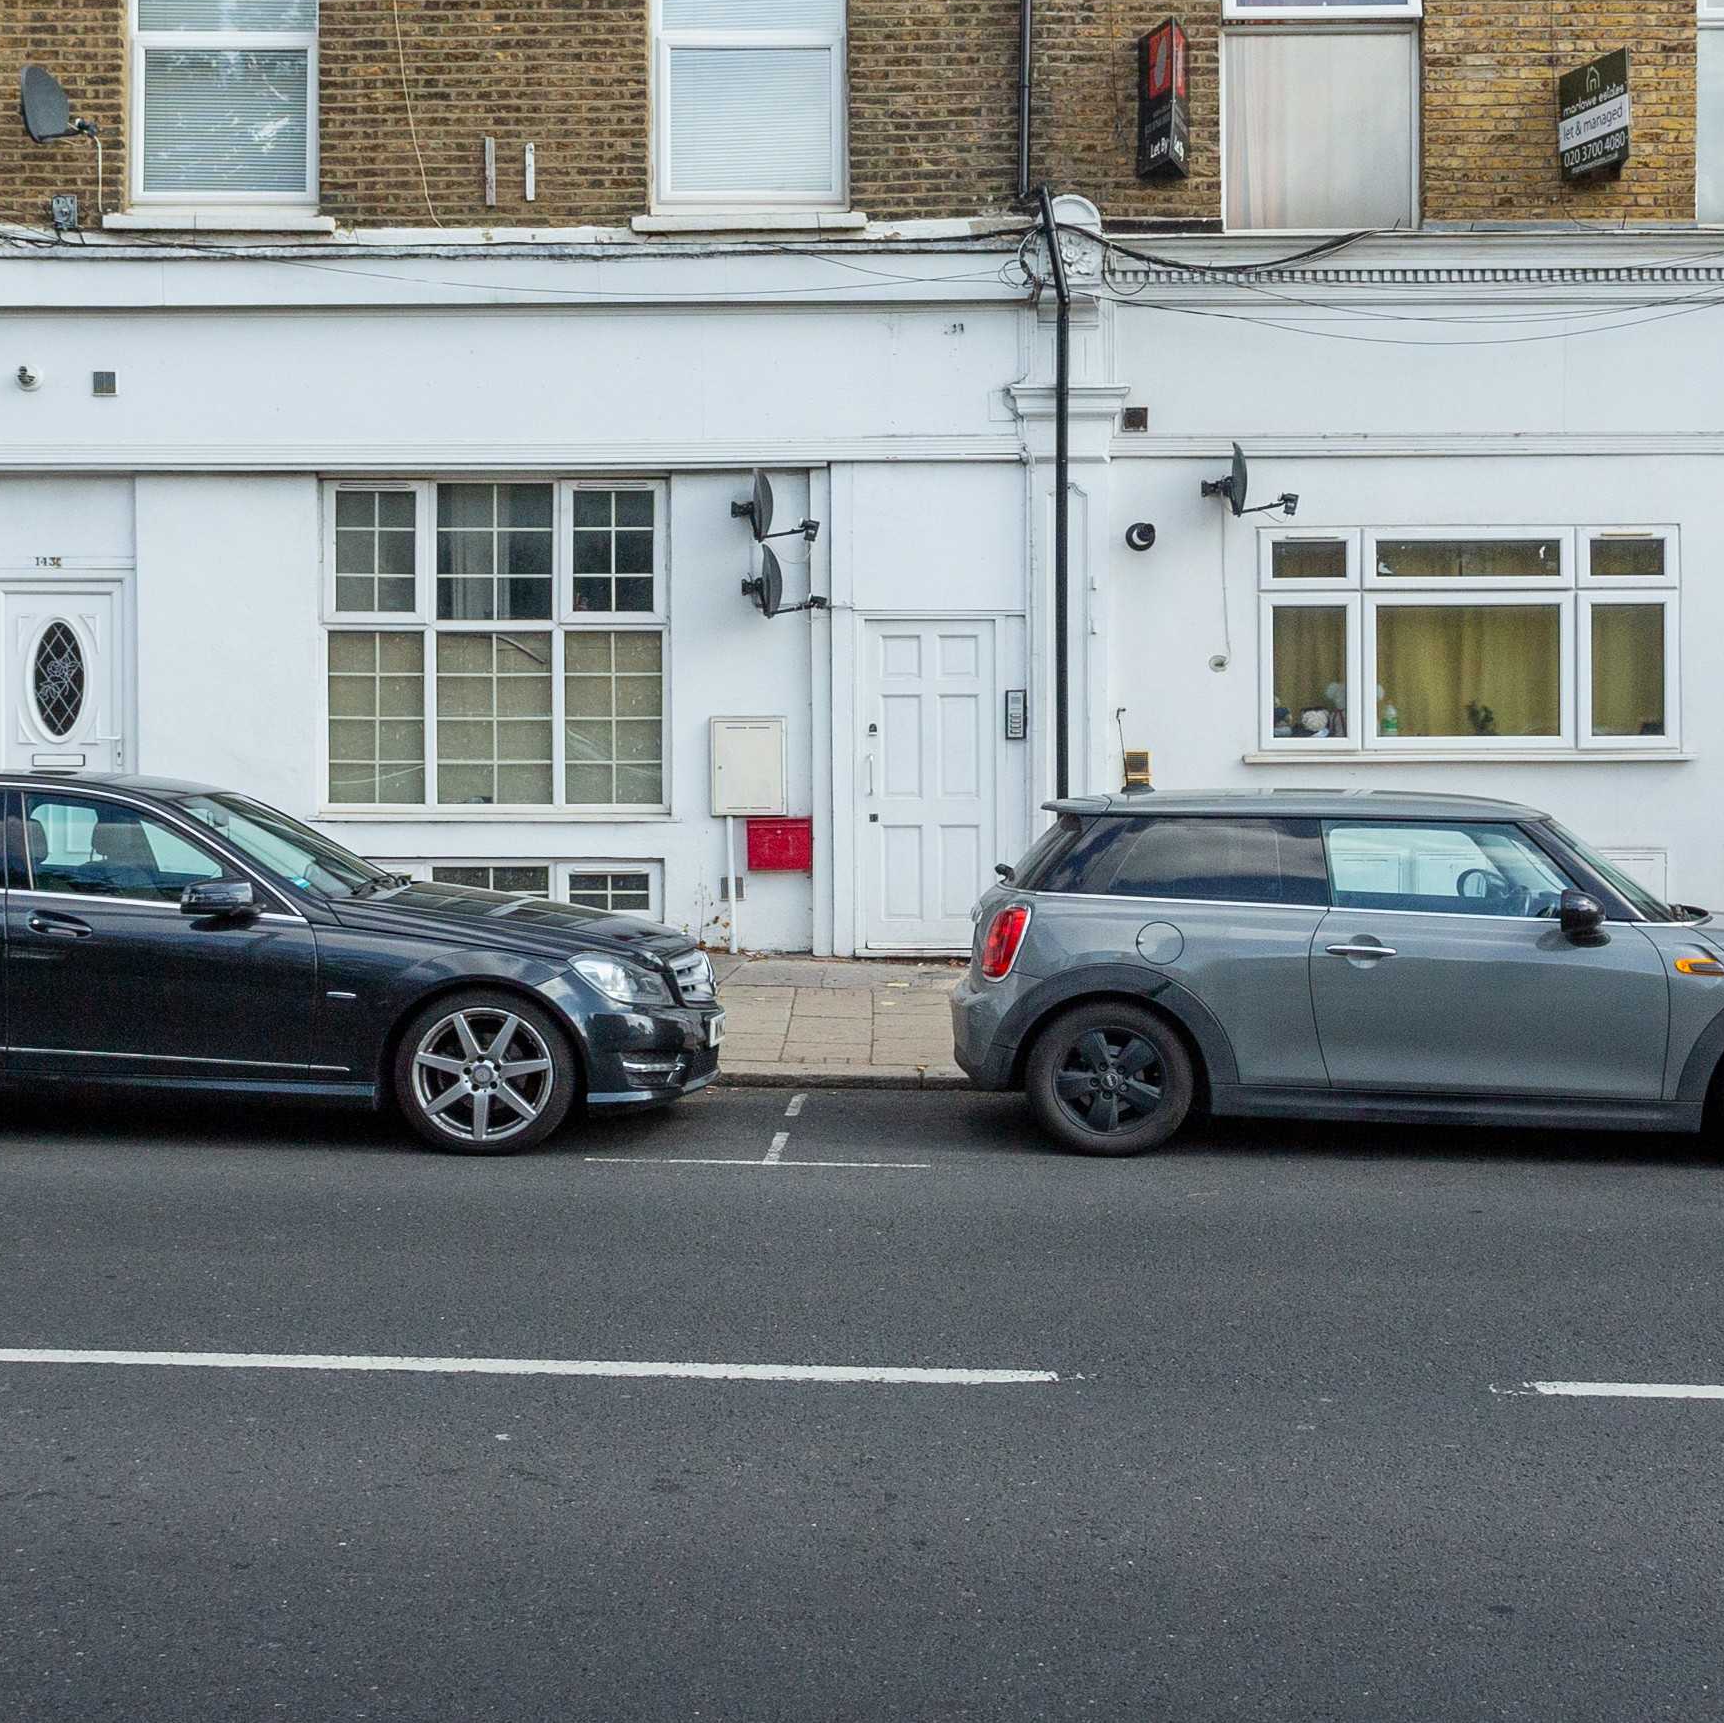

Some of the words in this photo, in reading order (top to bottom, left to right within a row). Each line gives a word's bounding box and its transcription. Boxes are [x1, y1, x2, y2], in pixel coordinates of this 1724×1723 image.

[1563, 125, 1575, 142] let
[1583, 103, 1623, 132] managed
[1564, 149, 1580, 168] 020
[1581, 139, 1603, 163] 3700
